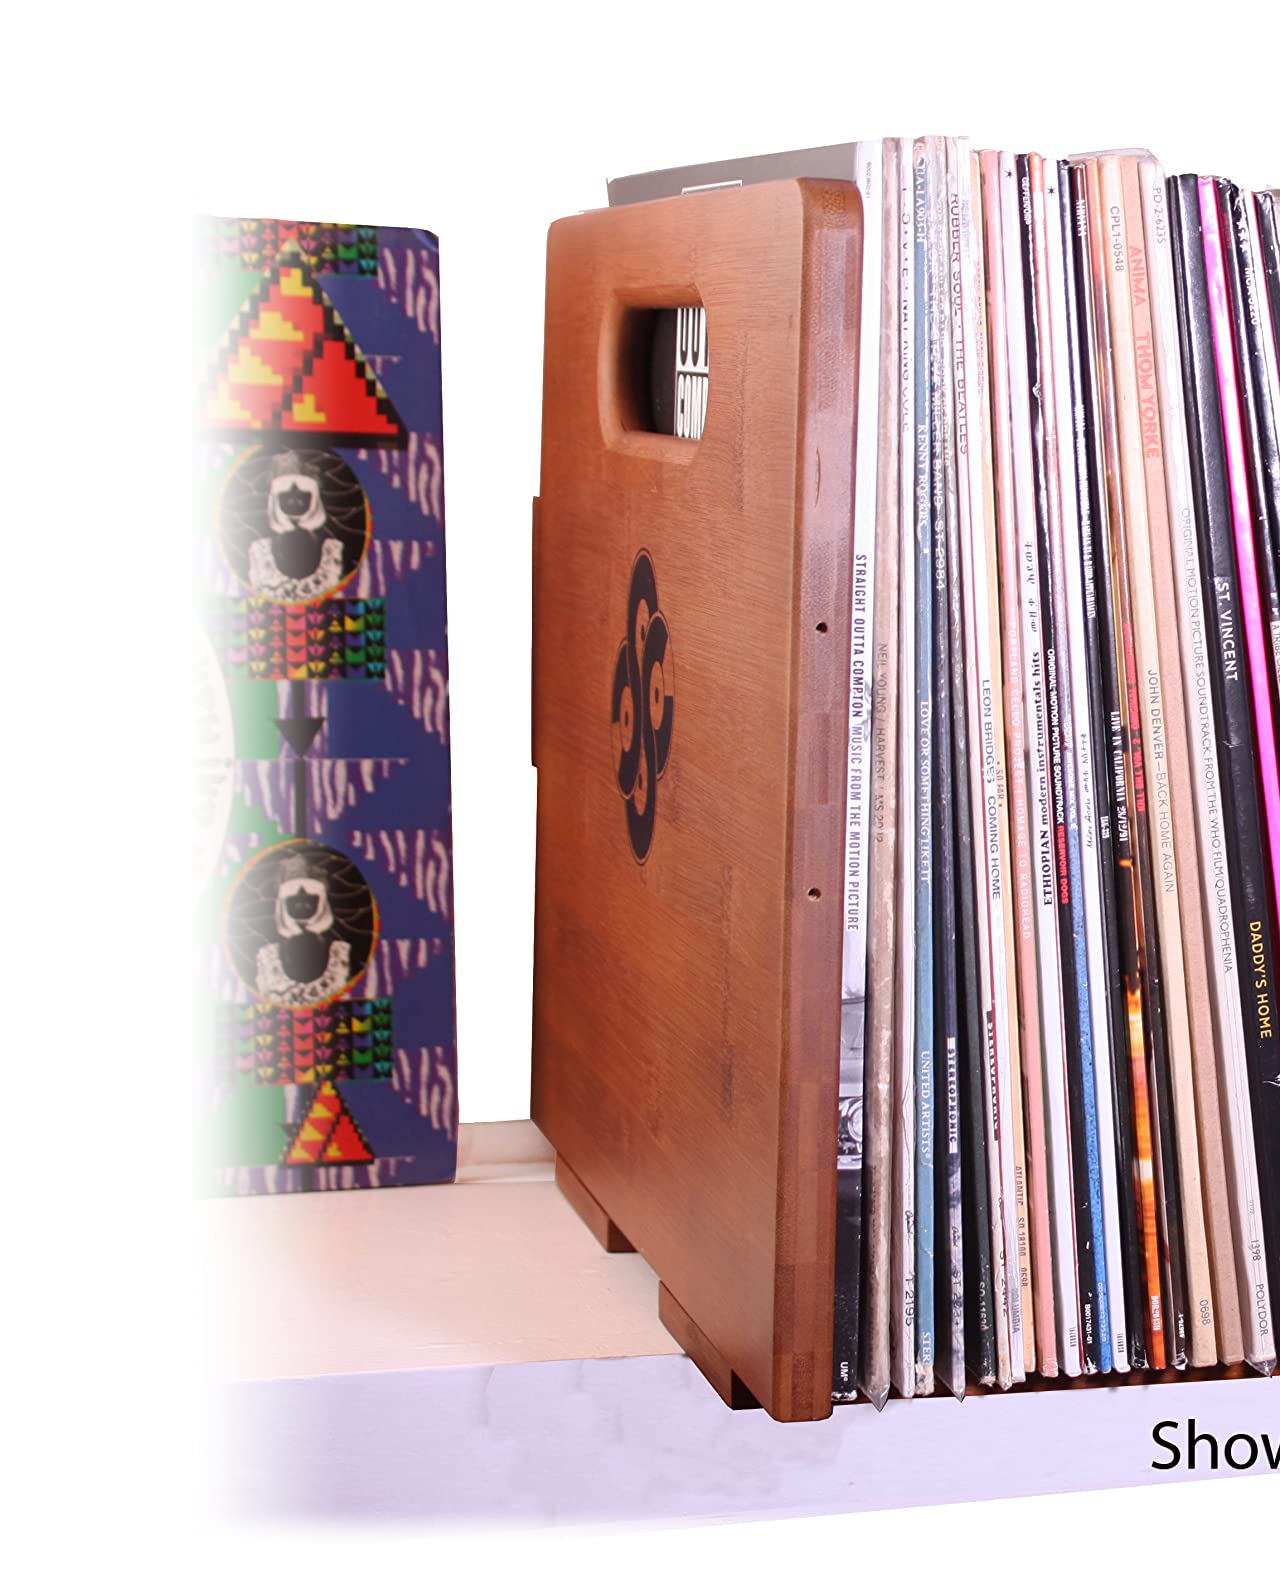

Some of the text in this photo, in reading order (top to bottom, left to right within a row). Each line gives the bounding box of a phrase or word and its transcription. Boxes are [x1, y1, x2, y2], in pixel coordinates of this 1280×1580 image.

[1109, 206, 1124, 271] CPL1-0548
[1152, 187, 1166, 243] PD-2-6235
[950, 194, 967, 454] RUBBER BEATLES
[1128, 246, 1159, 458] ANIMA THOM YORKE
[875, 644, 887, 780] NEIL YOUNG HARVEST
[918, 424, 930, 882] KENNY ROGERS LOVE OR SOMETHING LIKE IT
[1216, 582, 1238, 680] ST. VINCENT
[847, 554, 866, 930] STRAIGHT OUTTA COMPTON MUSIC FROM THE MOTION PICTURE
[981, 680, 1000, 899] LEON BRIDGES COMING HOME
[1007, 621, 1031, 938] PORTLAND CELLO PROJECT HOMAGE TO RADIOHEAD
[1030, 651, 1052, 905] ETHIOPIAN modern instrumentals hits
[1046, 649, 1068, 904] ORIGINAL MOTION PICTURE SOUNDTRACK RESERVOIR DOGS
[1109, 712, 1125, 801] LIVE IN CALIFORNIA
[1146, 670, 1175, 892] JOHN DENVER BACK HOME AGAIN
[1179, 508, 1233, 973] ORIGINAL MOTION PICTURE SOUNDTRACK FROM THE WHO FILM/QUADROPHENIA
[1248, 921, 1272, 1038] DADDY'S HOME
[920, 1050, 930, 1099] UNITED
[947, 1048, 956, 1142] STEREOPHONIC
[1198, 1300, 1210, 1325] 0698
[1249, 1239, 1269, 1335] 1398 POLYDOR
